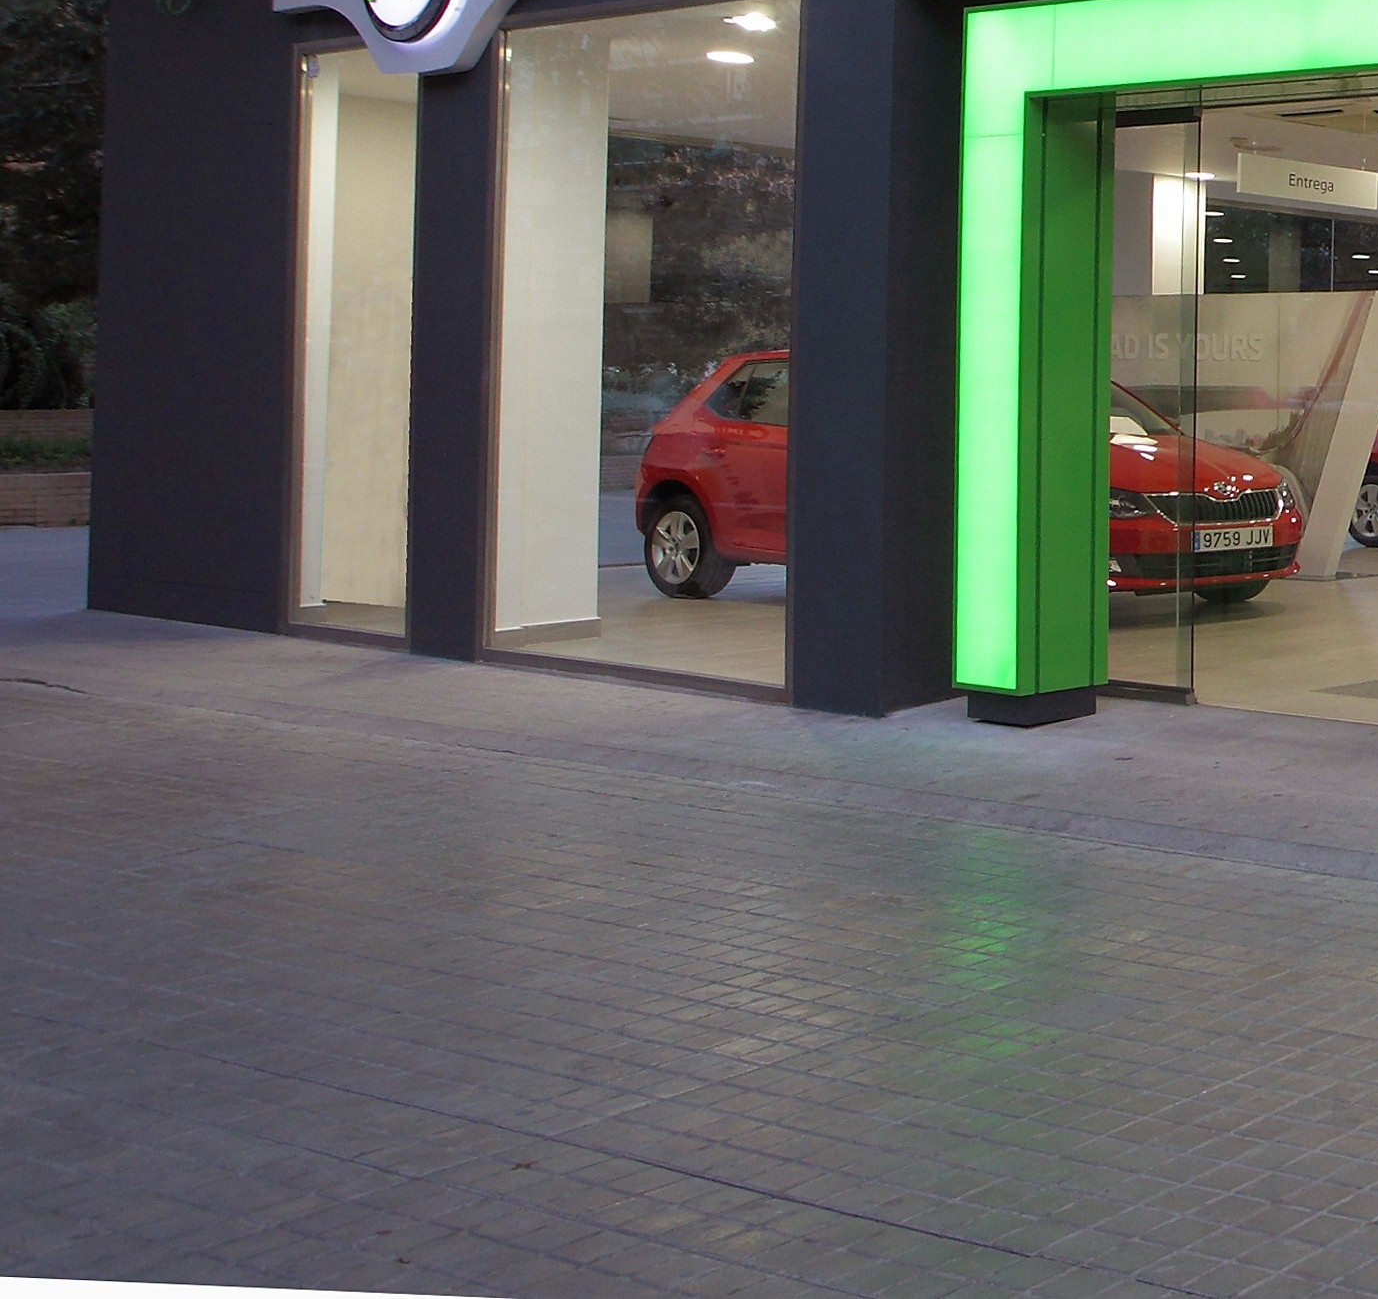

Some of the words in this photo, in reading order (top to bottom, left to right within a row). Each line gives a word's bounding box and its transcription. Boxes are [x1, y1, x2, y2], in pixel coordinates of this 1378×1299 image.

[1288, 173, 1334, 194] Entrega
[1148, 333, 1169, 361] IS
[1176, 333, 1264, 362] YOURS
[1203, 531, 1240, 548] 9759
[1246, 529, 1270, 545] JJV
